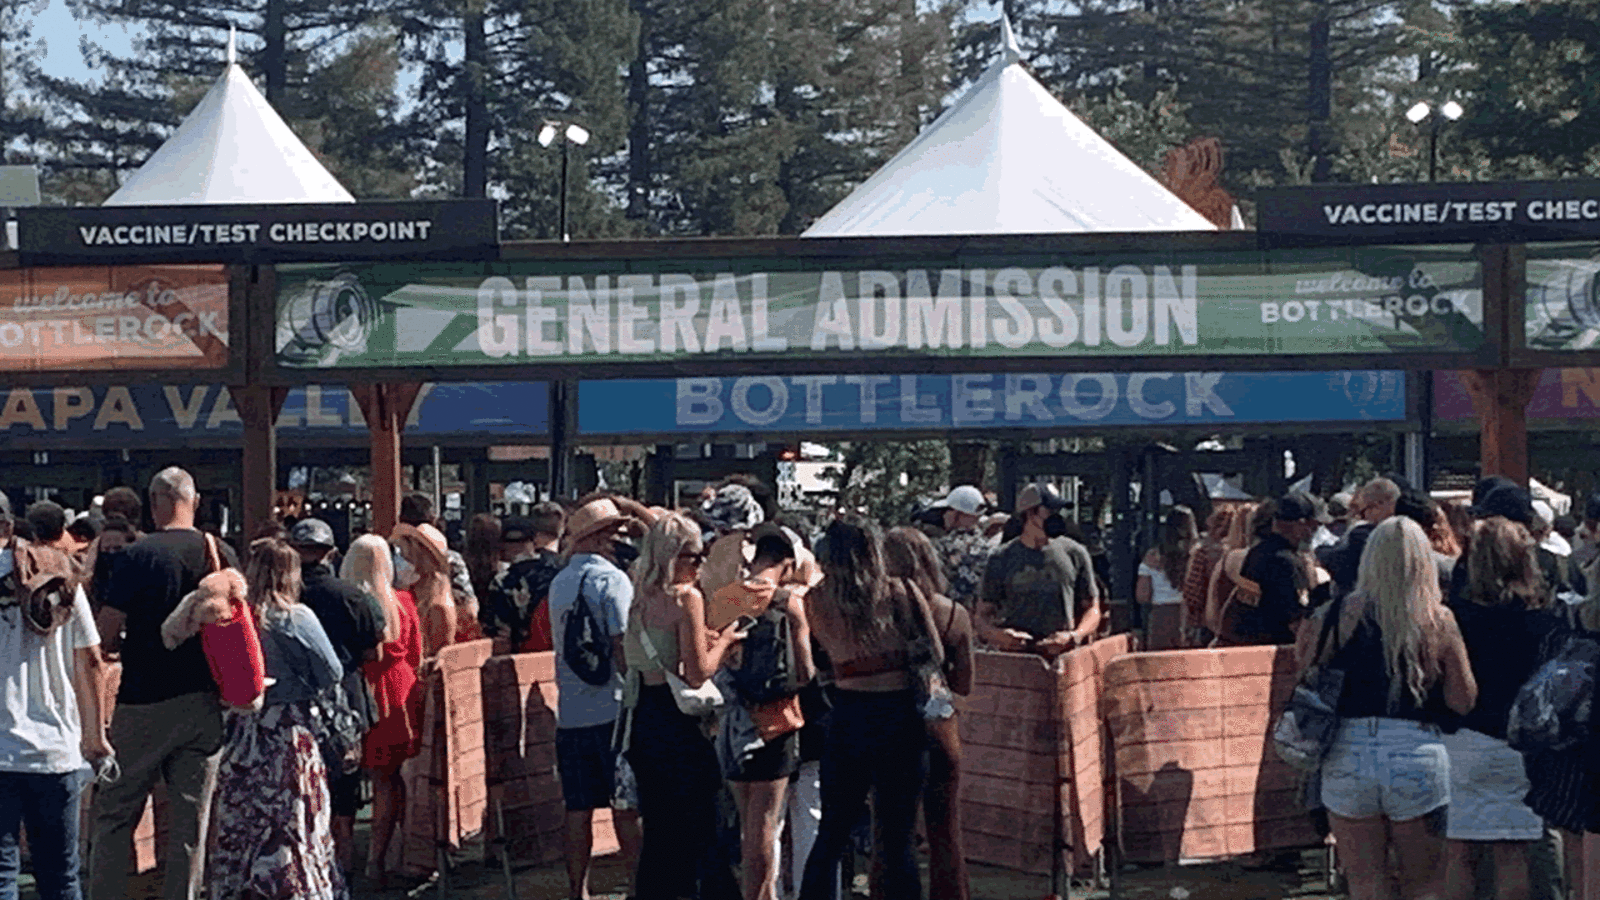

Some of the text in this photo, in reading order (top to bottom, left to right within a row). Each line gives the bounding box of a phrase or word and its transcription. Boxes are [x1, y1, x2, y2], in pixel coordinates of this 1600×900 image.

[1323, 202, 1518, 224] VACCINE/TEST
[80, 220, 431, 246] VACCINE/TEST CHECKPOINT
[1295, 267, 1434, 293] welcome to
[13, 281, 177, 312] welcome to
[476, 264, 1199, 358] GENERAL ADMISSION
[1260, 293, 1471, 323] BOTTLEROCK
[0, 311, 220, 347] OTTLEROCK
[675, 371, 1234, 427] BOTTLEROCK
